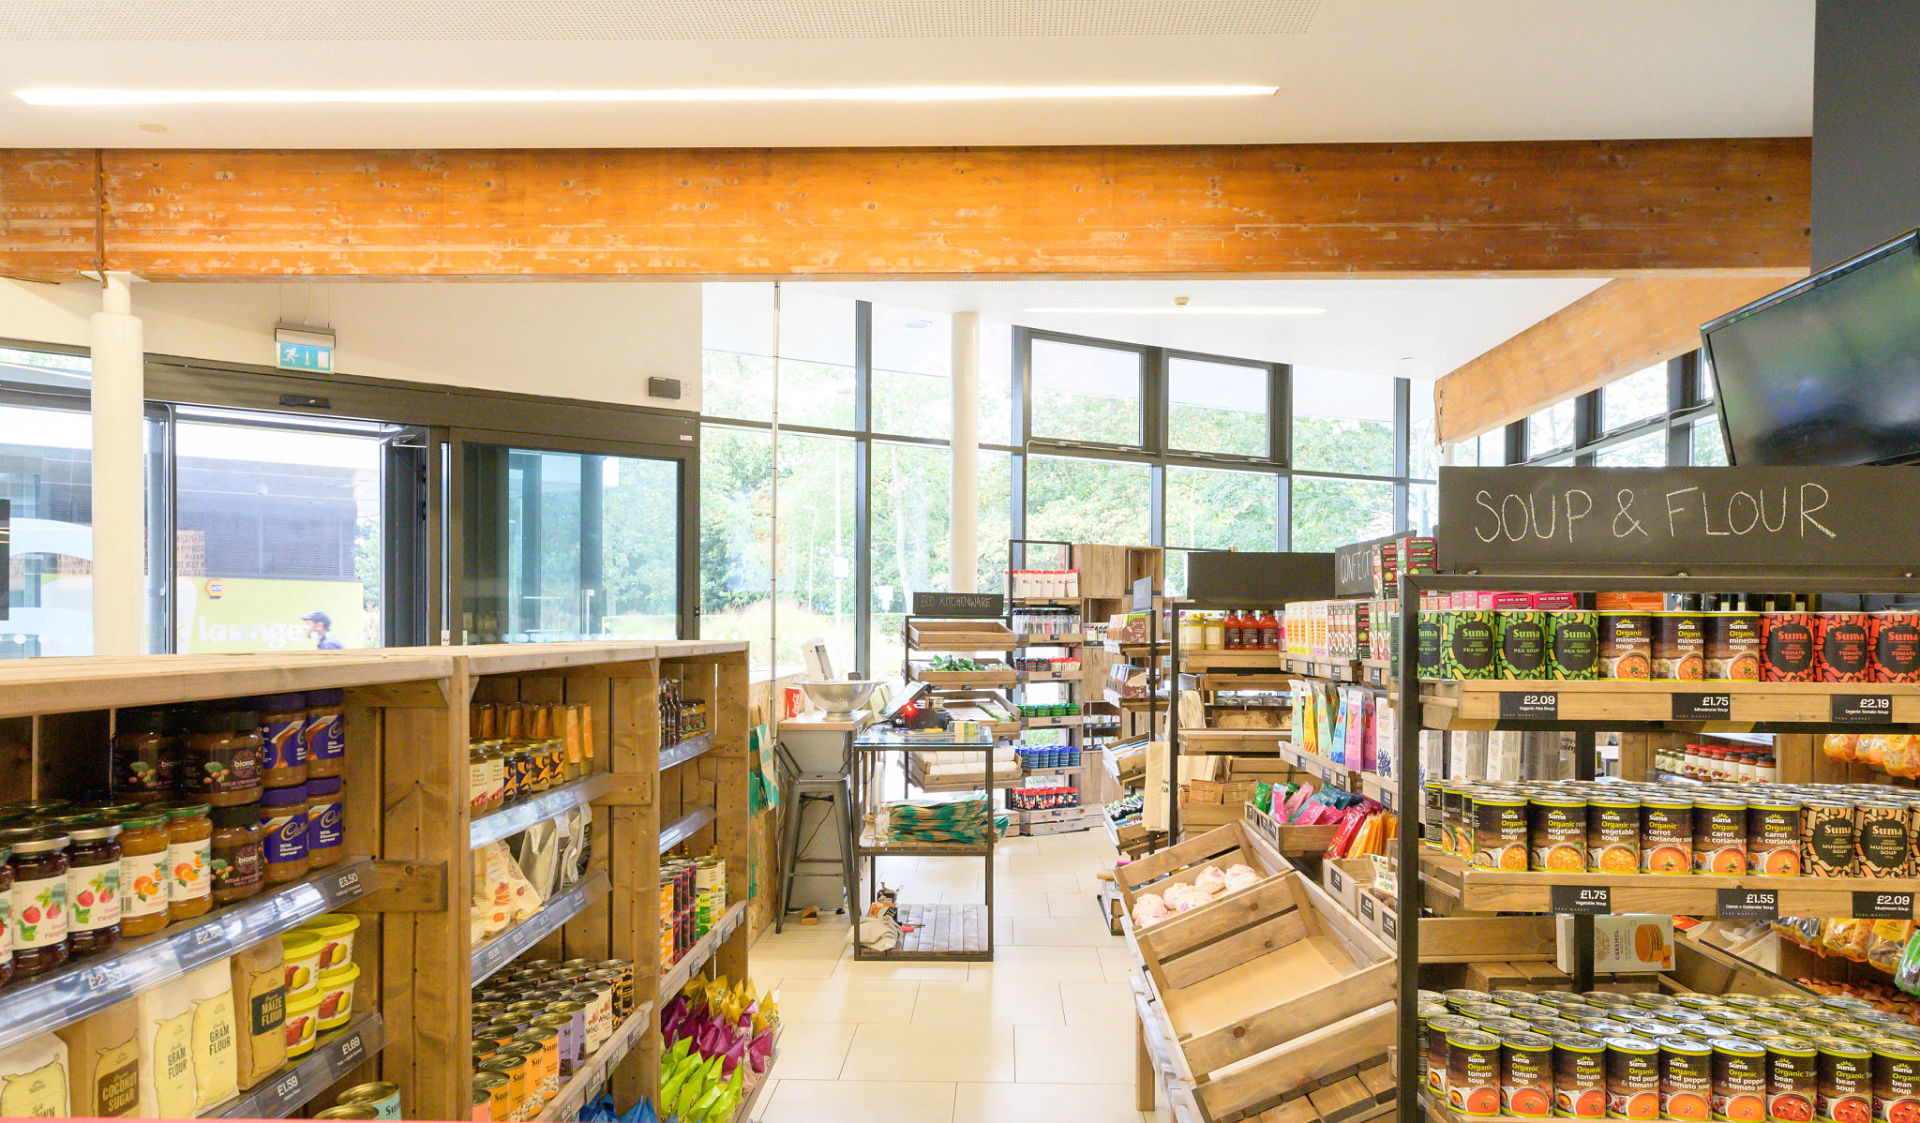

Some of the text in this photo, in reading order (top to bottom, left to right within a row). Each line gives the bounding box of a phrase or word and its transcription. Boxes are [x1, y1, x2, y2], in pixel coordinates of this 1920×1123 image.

[1475, 482, 1836, 543] SOUP & FLOUR
[1341, 550, 1372, 584] CONFECT
[198, 616, 304, 649] lounge
[1462, 628, 1489, 638] Suma
[1513, 628, 1539, 638] Suma
[1563, 628, 1591, 638] Suma
[1778, 631, 1807, 640] Suma
[1835, 632, 1864, 641] Suma
[1888, 632, 1918, 641] Suma
[1523, 695, 1555, 705] £2.09
[1702, 696, 1729, 706] £1.75
[1860, 698, 1889, 708] £2.19
[1649, 814, 1667, 822] Suma
[1712, 816, 1731, 824] Suma
[1548, 820, 1574, 828] Organic
[1649, 822, 1676, 830] Organic
[1712, 824, 1738, 832] Organic
[1765, 824, 1792, 832] Organic
[1548, 828, 1580, 836] vegetable
[1602, 828, 1634, 836] vegetable
[1824, 824, 1851, 834] Suma
[1872, 826, 1903, 834] Suma
[338, 872, 359, 888] £3.50
[1580, 890, 1607, 900] £1.75
[1746, 894, 1774, 904] £1.55
[1876, 896, 1910, 905] £2.09
[261, 997, 282, 1014] MAIZE
[261, 1010, 282, 1028] FLOUR
[209, 1025, 230, 1043] GRAM
[209, 1036, 232, 1056] FLOUR
[168, 1047, 186, 1066] GRAM
[1468, 1056, 1486, 1064] Suma
[1512, 1056, 1530, 1064] Suma
[1468, 1064, 1494, 1072] Organic
[1512, 1063, 1540, 1072] Organic
[1629, 1060, 1648, 1068] Suma
[1670, 1060, 1688, 1068] Suma
[1728, 1062, 1748, 1070] Suma
[1775, 1062, 1794, 1070] Suma
[1836, 1064, 1856, 1072] Suma
[168, 1060, 188, 1080] FLOUR
[1629, 1068, 1654, 1076] Organic
[1670, 1068, 1698, 1076] Organic
[1728, 1070, 1757, 1078] Organic
[1775, 1068, 1804, 1076] Organic
[1892, 1066, 1912, 1074] Suma
[1512, 1070, 1538, 1080] tomato
[1775, 1074, 1794, 1082] bean
[1836, 1070, 1864, 1080] Organic
[1468, 1077, 1485, 1085] soup
[1512, 1077, 1529, 1086] soup
[1576, 1080, 1594, 1088] soup
[1684, 1076, 1707, 1084] pepper
[1836, 1076, 1856, 1086] bean
[1892, 1079, 1912, 1088] bean
[102, 1072, 138, 1102] COCONUT
[1670, 1081, 1697, 1089] tomato
[1728, 1082, 1756, 1091] tomato
[1775, 1081, 1794, 1090] soup
[1836, 1084, 1856, 1093] soup
[1892, 1086, 1912, 1096] soup
[108, 1088, 136, 1112] SUGAR
